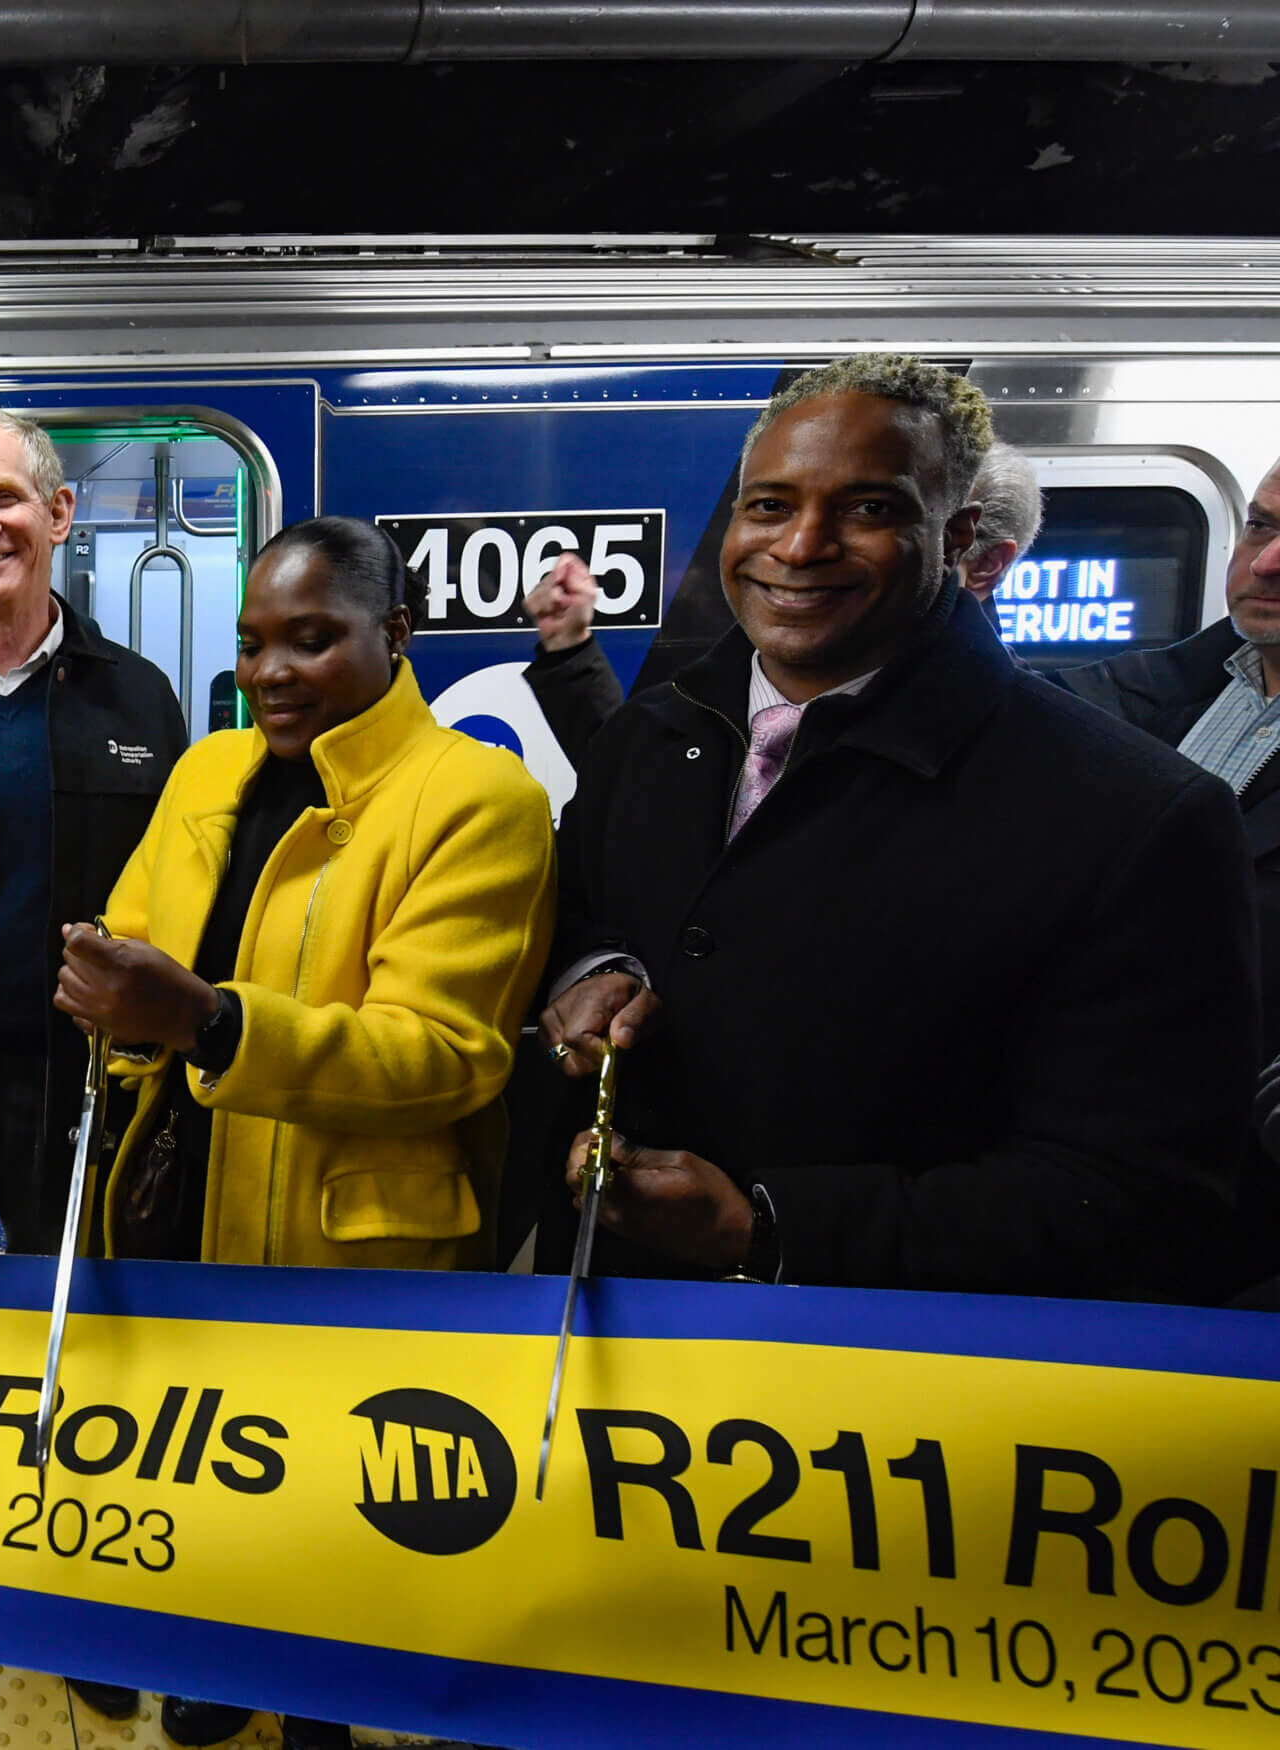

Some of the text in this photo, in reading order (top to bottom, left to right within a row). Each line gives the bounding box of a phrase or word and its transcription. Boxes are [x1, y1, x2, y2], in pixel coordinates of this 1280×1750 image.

[76, 545, 90, 555] R2
[407, 525, 644, 619] 4065
[1078, 560, 1118, 598] IN
[999, 603, 1133, 642] ERVICE
[1, 1492, 177, 1573] 2023
[575, 1408, 1280, 1612] R211 Rol
[724, 1586, 1280, 1716] March 10, 2023
